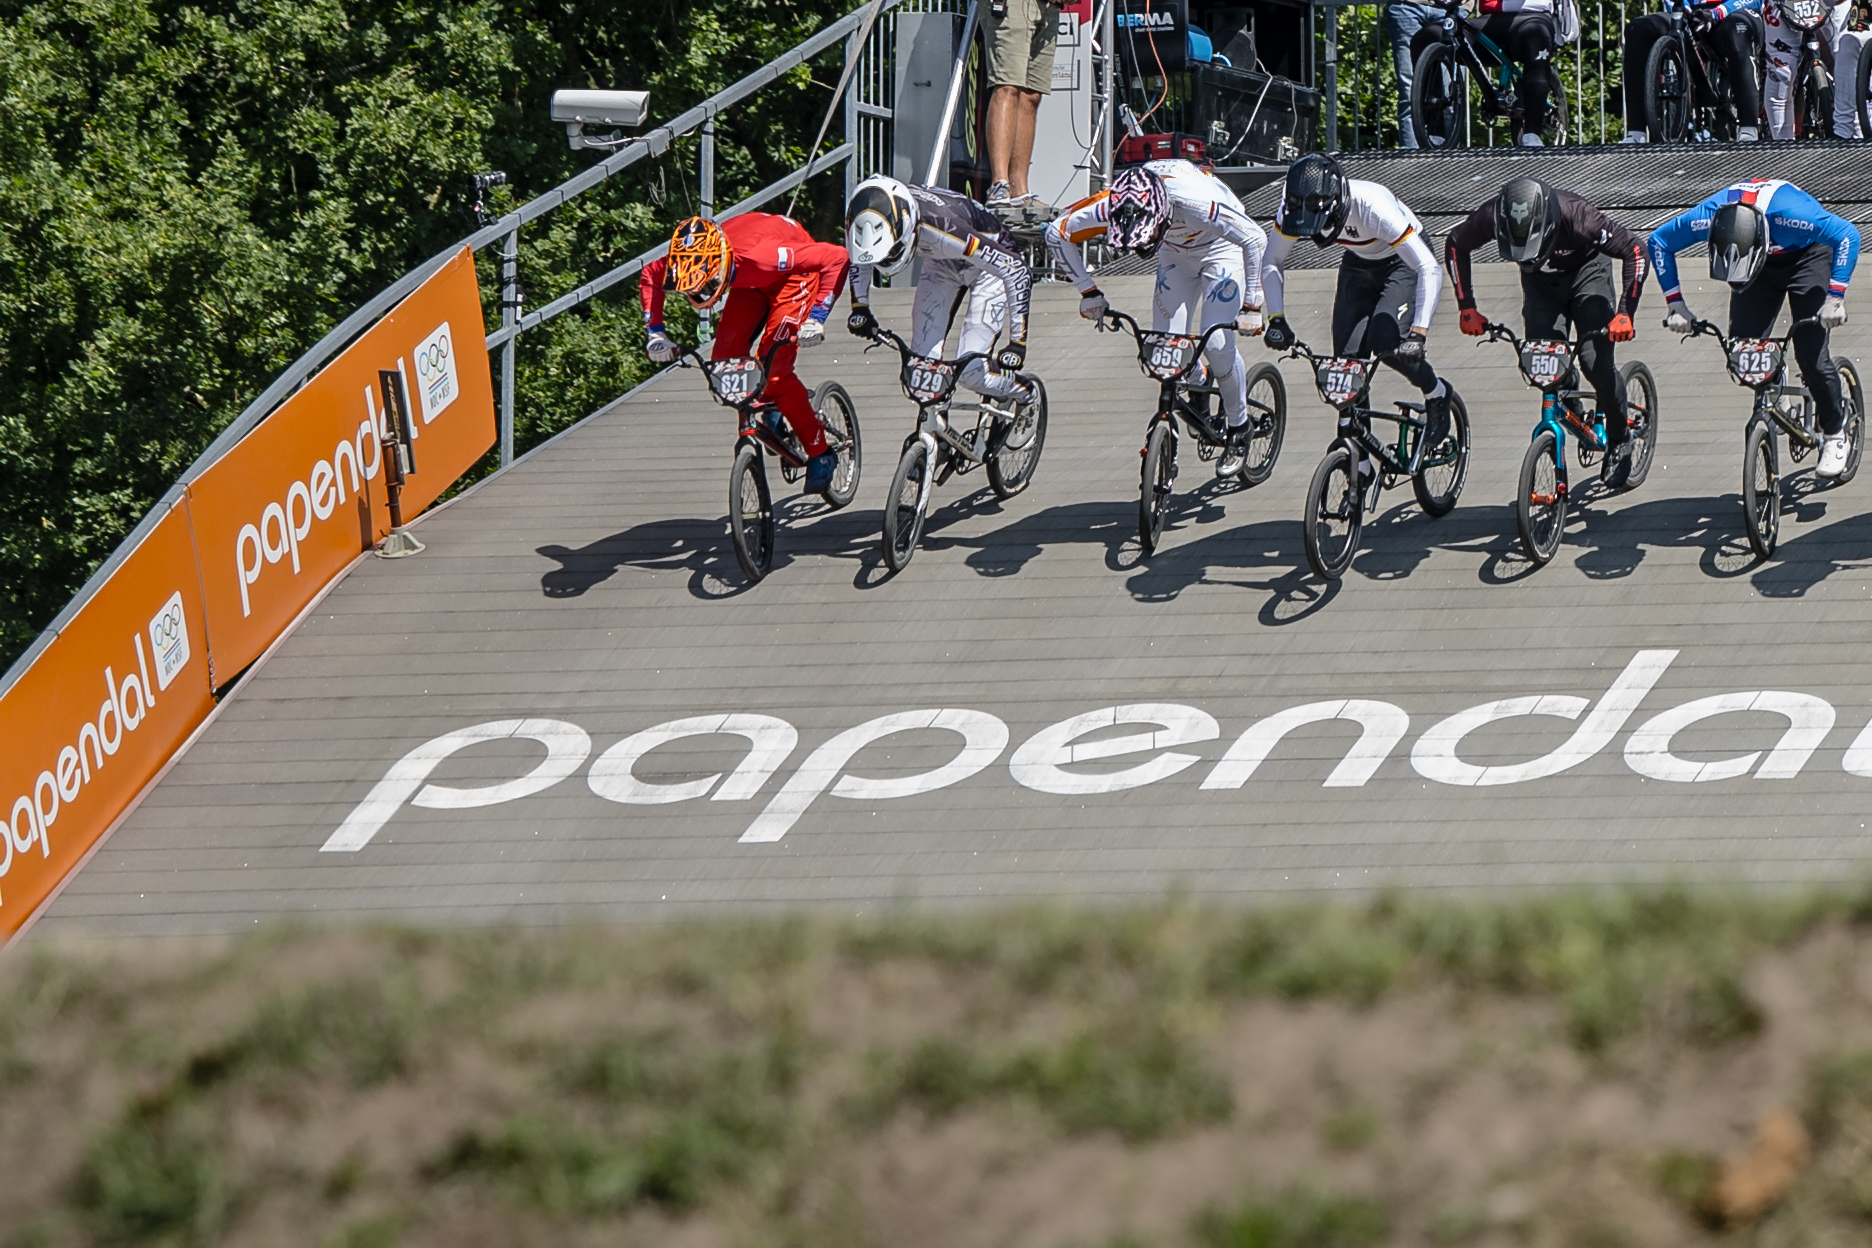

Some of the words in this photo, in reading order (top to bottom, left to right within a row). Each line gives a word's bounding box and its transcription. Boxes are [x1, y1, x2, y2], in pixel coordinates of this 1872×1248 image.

[1793, 0, 1820, 18] 552
[1116, 11, 1175, 28] BERMA
[1774, 216, 1815, 232] SKODA
[981, 245, 1032, 315] HEXAGON
[1151, 347, 1183, 367] 659
[1530, 355, 1559, 375] 550
[1738, 352, 1771, 372] 625
[720, 372, 748, 393] 621
[910, 369, 943, 393] 629
[1326, 372, 1353, 393] 574
[235, 356, 419, 618] papendl
